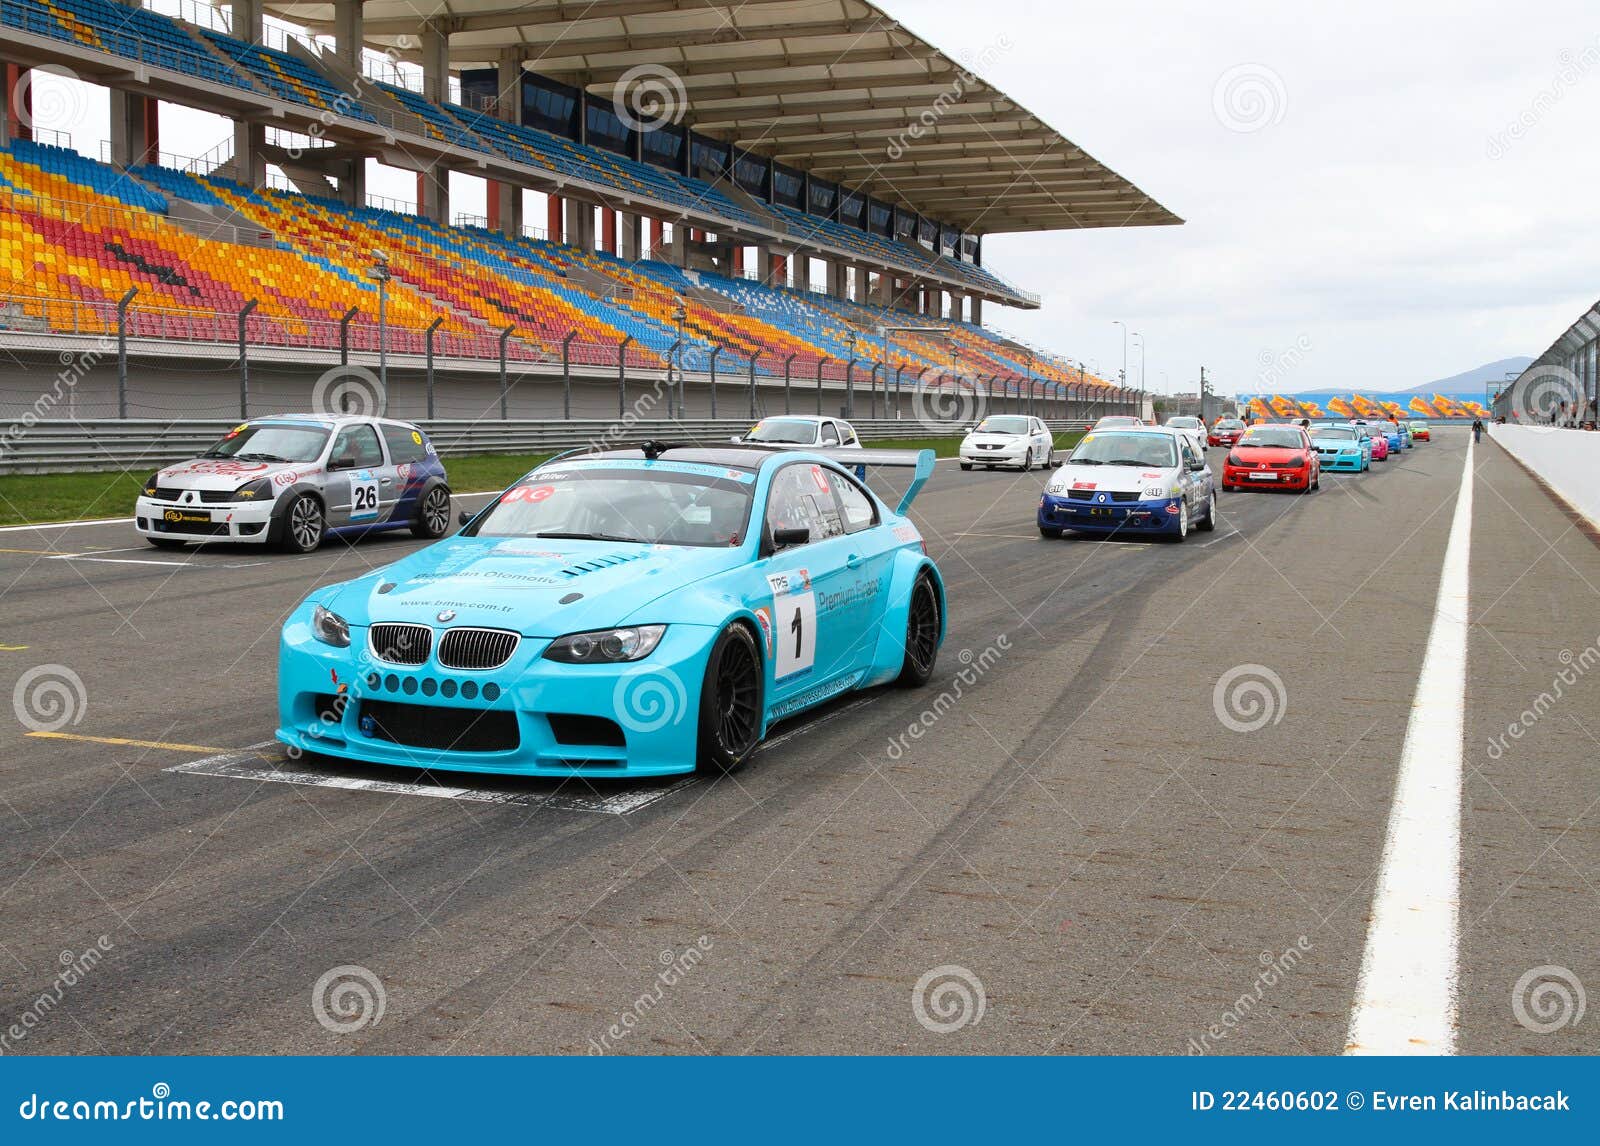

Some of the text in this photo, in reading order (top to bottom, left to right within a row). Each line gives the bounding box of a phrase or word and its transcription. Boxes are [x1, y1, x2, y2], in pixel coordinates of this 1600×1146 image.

[355, 485, 377, 511] 26
[484, 571, 558, 584] Otomotiv
[771, 577, 788, 590] TPS
[400, 599, 514, 613] www.bmw.com.tr
[791, 607, 801, 659] 1
